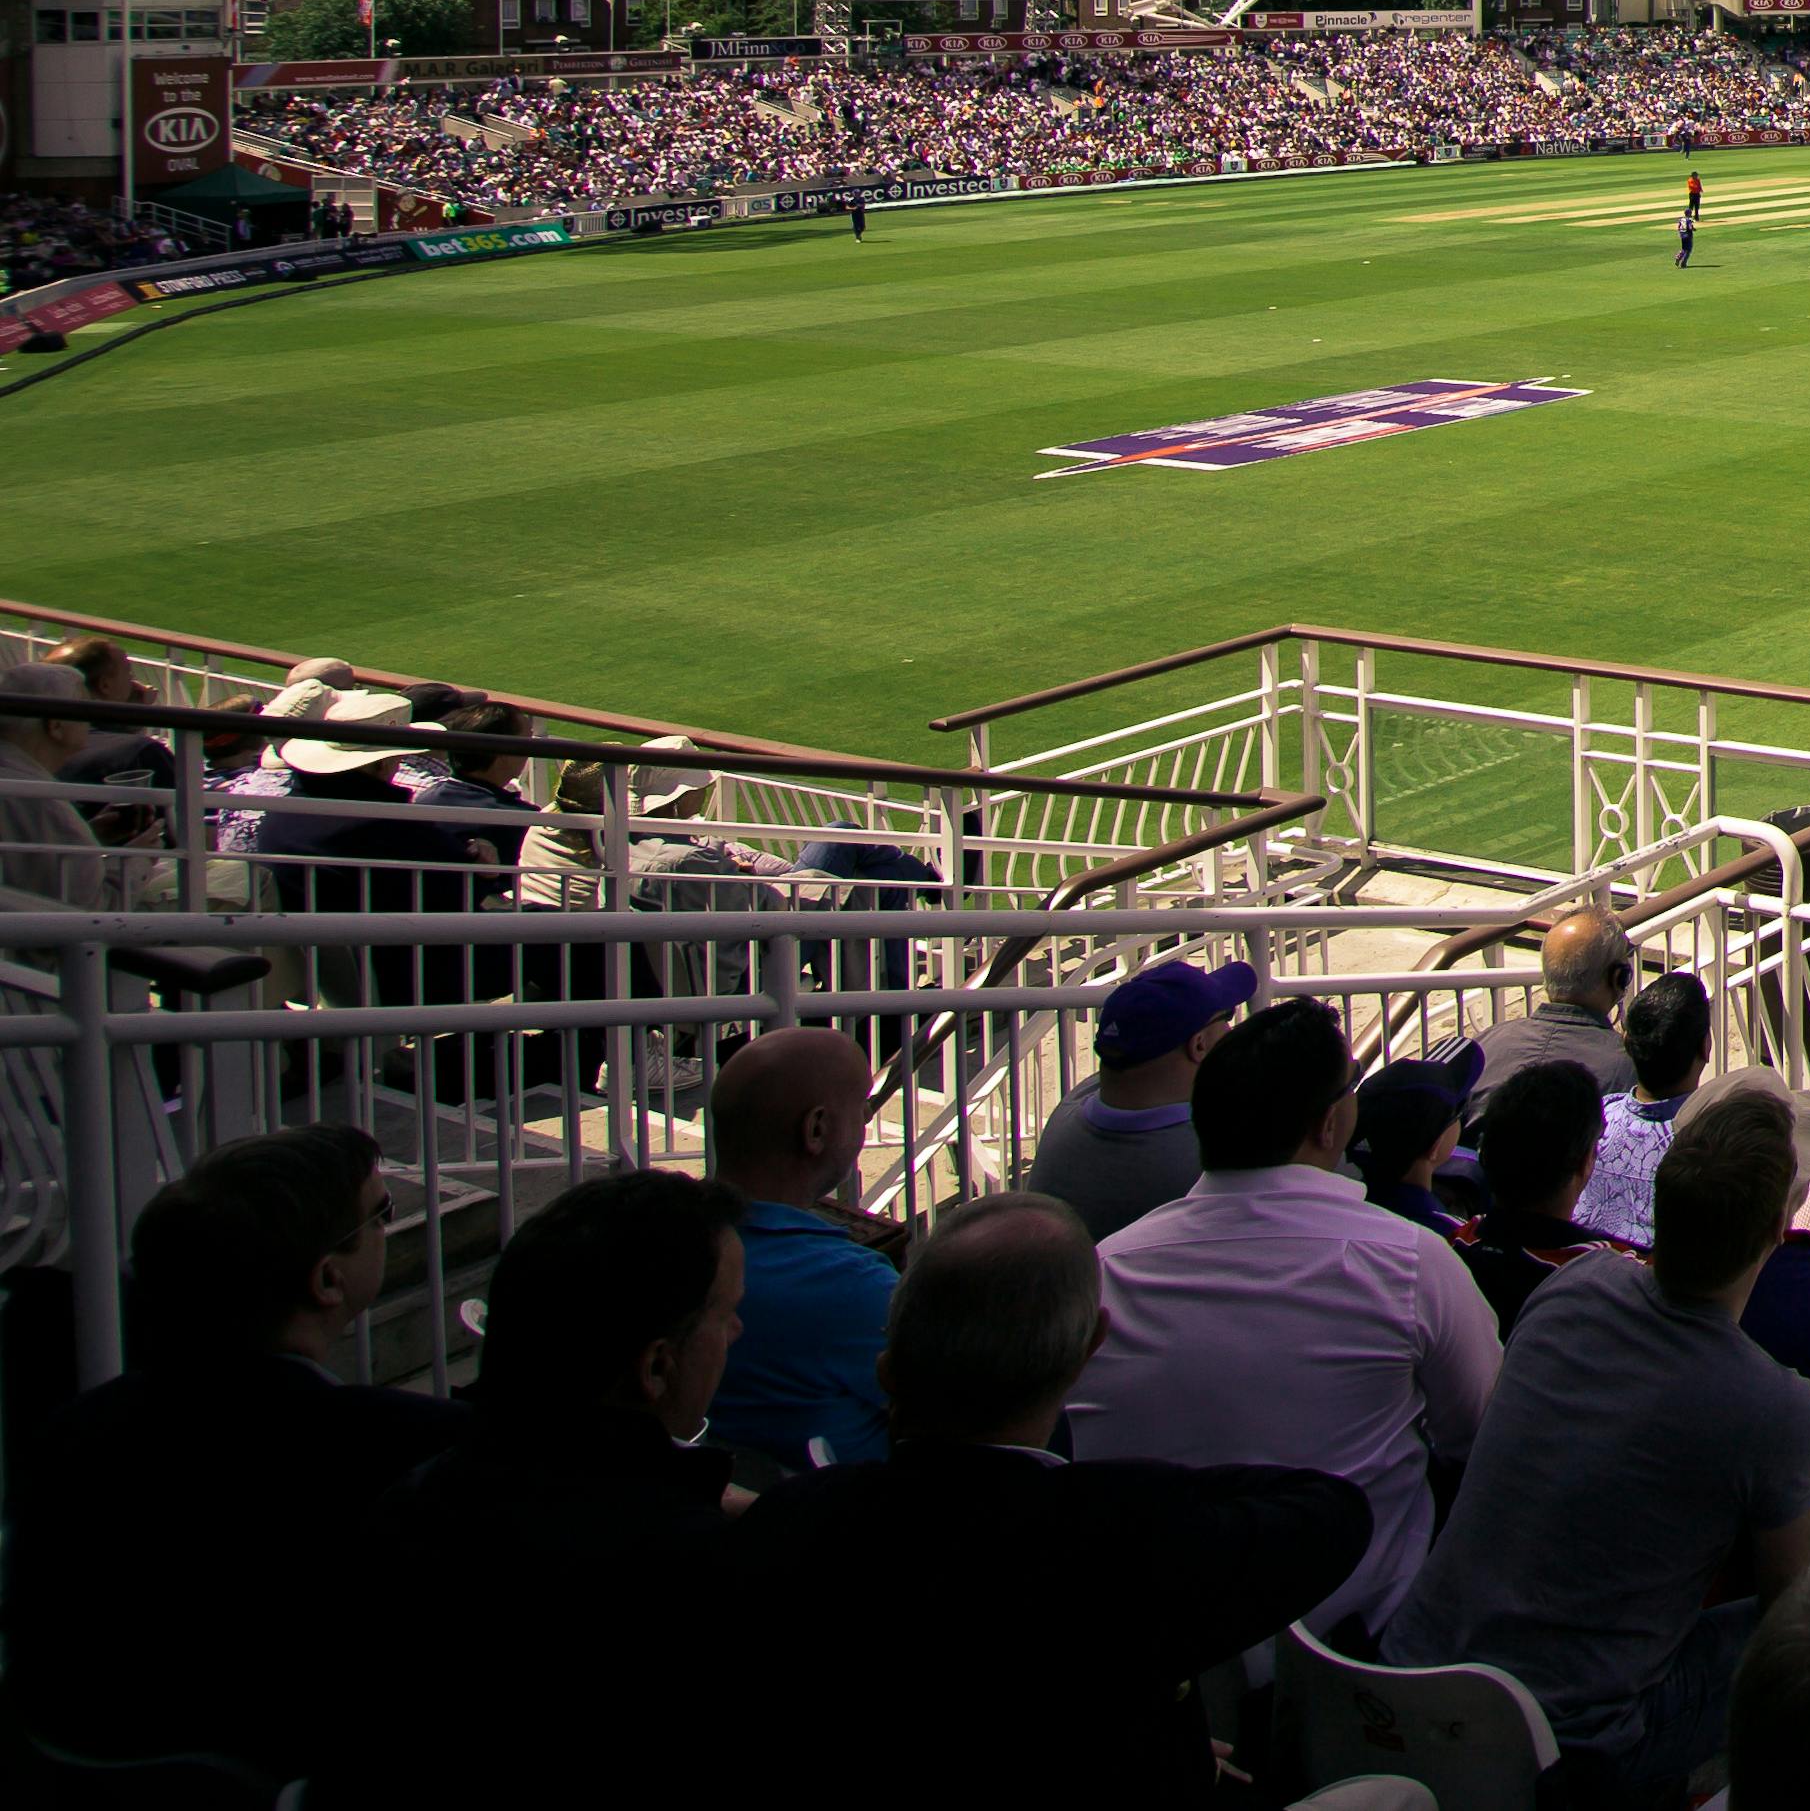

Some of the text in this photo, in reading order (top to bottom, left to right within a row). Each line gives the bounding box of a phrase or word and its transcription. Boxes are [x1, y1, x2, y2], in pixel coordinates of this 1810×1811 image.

[1315, 14, 1367, 27] Pinnacle
[710, 41, 806, 58] JMFinn&Co
[405, 61, 462, 79] M.A.R.
[153, 72, 210, 85] Welcome
[163, 90, 202, 102] to the
[1535, 140, 1592, 155] NatWest
[167, 157, 200, 172] OVAL
[907, 179, 992, 204] Investec
[631, 202, 720, 228] Investec
[419, 229, 563, 257] bet365.com
